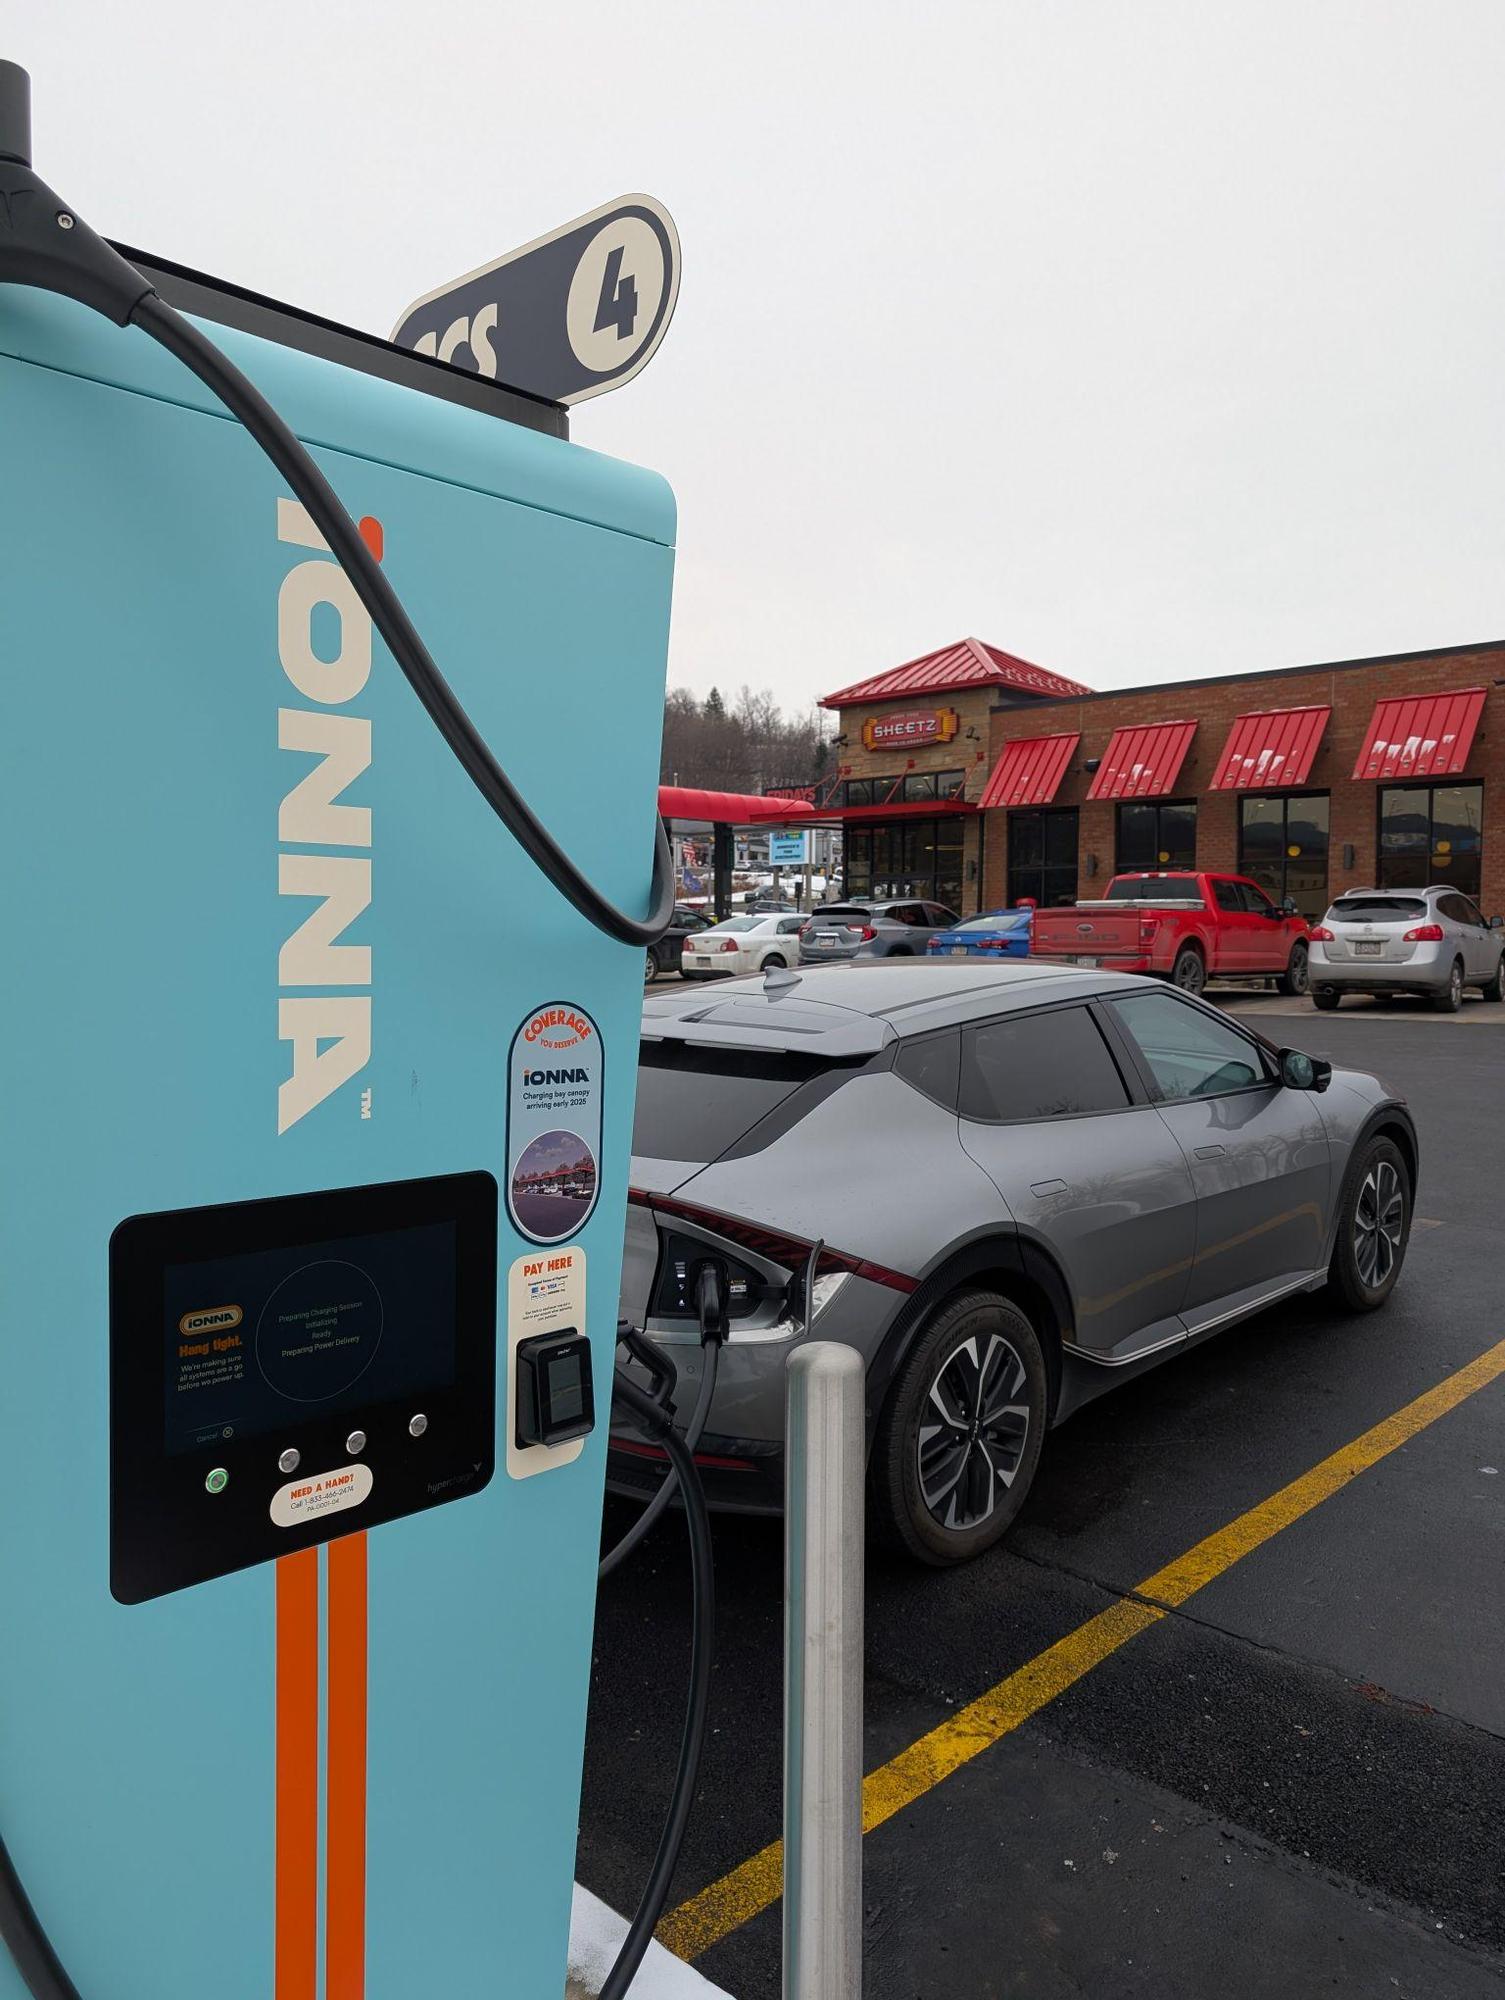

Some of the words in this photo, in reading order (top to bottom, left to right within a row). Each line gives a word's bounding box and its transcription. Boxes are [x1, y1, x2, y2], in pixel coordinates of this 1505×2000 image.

[592, 245, 638, 341] 4
[874, 719, 936, 738] SHEETZ
[524, 1009, 592, 1042] COVERAGE
[540, 1037, 552, 1049] YOU
[554, 1035, 578, 1049] DESERVE
[522, 1090, 553, 1100] Charging
[554, 1090, 566, 1099] bay
[567, 1088, 591, 1098] canopy
[526, 1101, 552, 1110] arriving
[553, 1100, 569, 1109] early
[569, 1097, 587, 1106] 2025
[523, 1262, 544, 1277] PAY
[547, 1256, 573, 1272] HERE
[278, 1312, 310, 1322] Preparing
[179, 1343, 210, 1357] Hang
[281, 1345, 313, 1357] Preparing
[314, 1340, 335, 1351] Power
[335, 1335, 361, 1346] Delivery
[202, 1358, 226, 1368] making
[177, 1381, 200, 1392] before
[201, 1378, 211, 1386] we
[211, 1373, 232, 1385] power
[179, 1374, 188, 1382] all
[188, 1369, 215, 1380] systems
[290, 1486, 313, 1500] NEED
[315, 1483, 323, 1493] A
[325, 1474, 355, 1490] HAND?
[290, 1499, 303, 1510] Call
